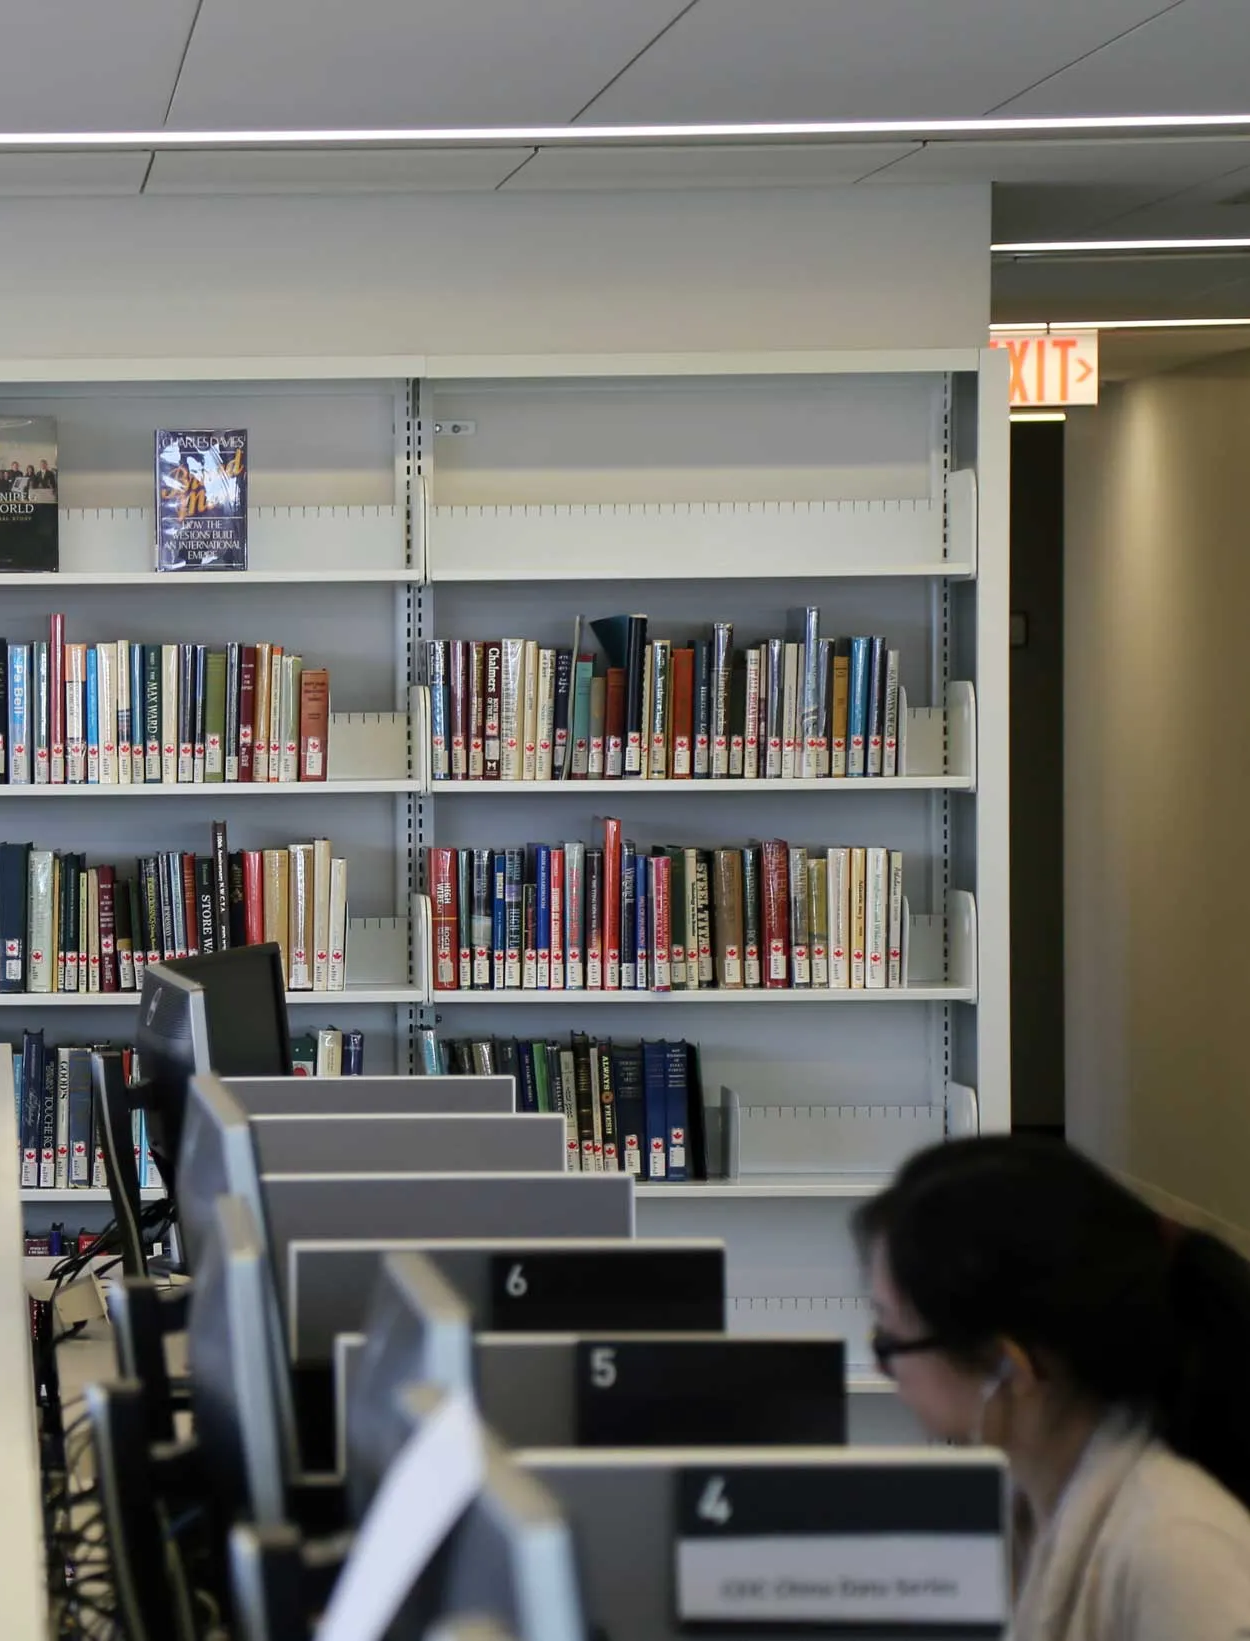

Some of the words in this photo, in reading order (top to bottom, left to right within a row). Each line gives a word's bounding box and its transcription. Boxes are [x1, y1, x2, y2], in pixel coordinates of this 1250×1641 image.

[988, 339, 1077, 402] XIT
[207, 520, 222, 528] THE
[212, 531, 233, 539] BUILT
[178, 541, 240, 549] INTERNATIONAL
[14, 664, 24, 683] Pa
[487, 647, 500, 693] Chalmers
[14, 687, 24, 715] Bell
[147, 681, 158, 702] MAX
[147, 705, 158, 735] WARD
[437, 883, 445, 905] WIRE
[443, 882, 452, 904] HIGH
[697, 863, 709, 908] STEEL
[201, 894, 213, 936] STORE
[697, 909, 710, 945] TITA
[204, 938, 214, 955] WA
[602, 1055, 612, 1091] ALWAYS
[44, 1096, 54, 1134] TOUCHE
[604, 1104, 614, 1135] FRESH
[43, 1135, 54, 1149] RO
[505, 1264, 527, 1297] 6
[590, 1348, 617, 1388] 5
[697, 1475, 733, 1525] 4
[839, 1575, 888, 1598] Data
[895, 1575, 958, 1597] Series
